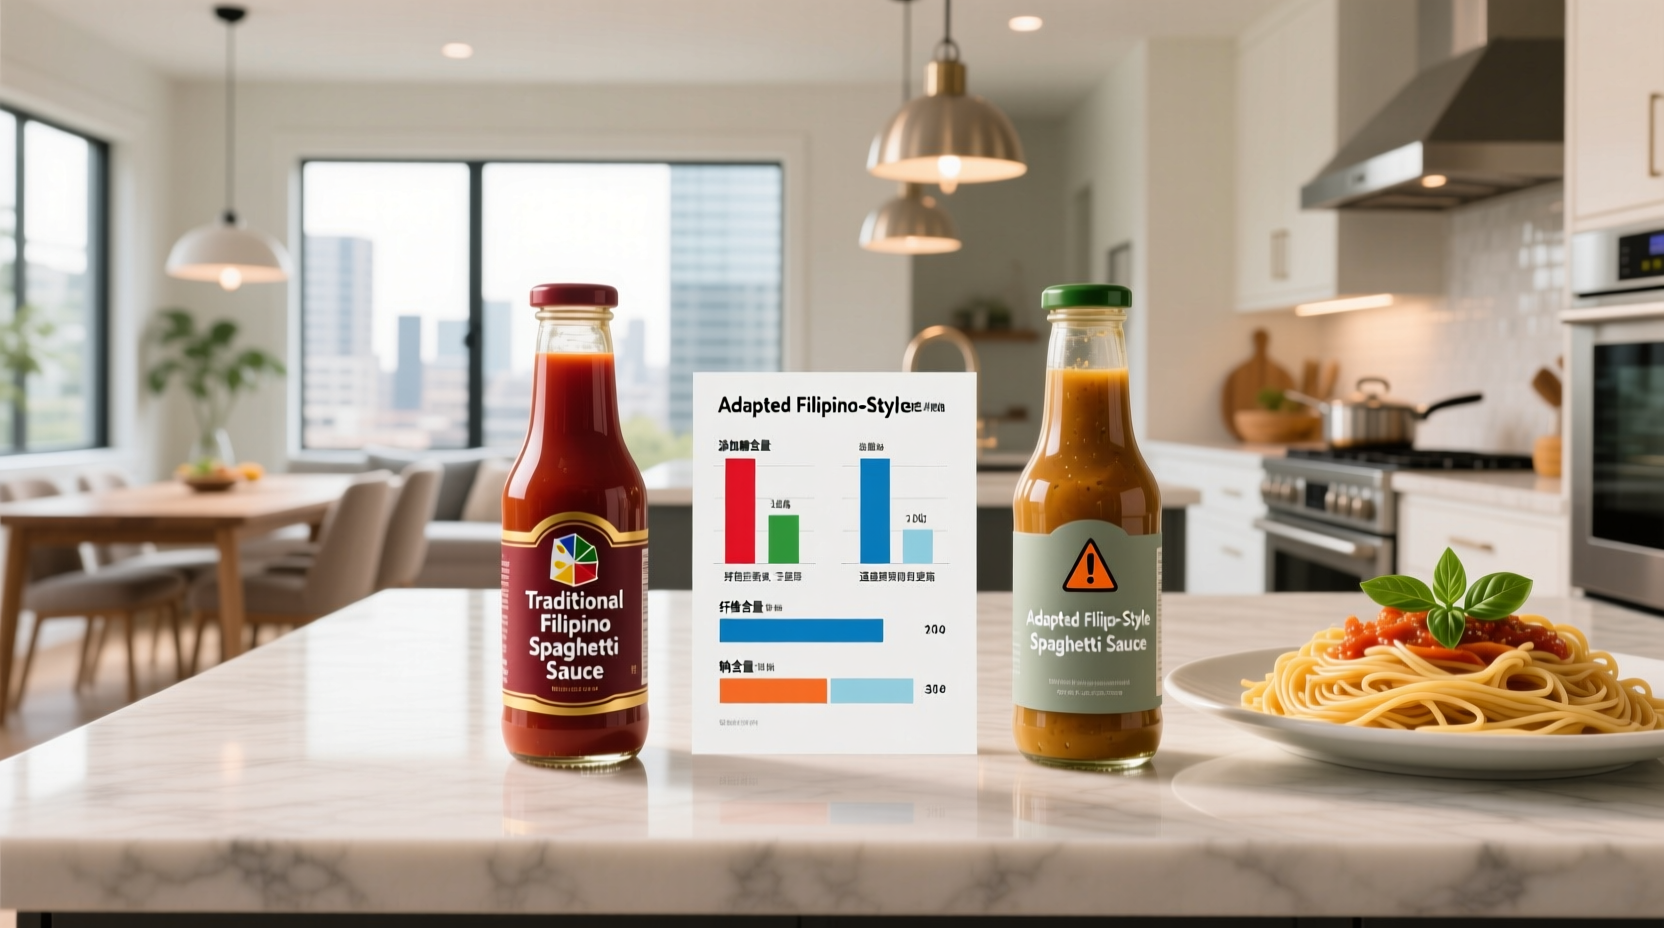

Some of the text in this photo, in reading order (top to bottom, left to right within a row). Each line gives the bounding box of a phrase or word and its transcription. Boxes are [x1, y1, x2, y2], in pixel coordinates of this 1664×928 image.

[718, 396, 790, 418] Adapted
[797, 396, 911, 418] Filipino-Style
[525, 588, 624, 609] Traditional
[540, 613, 611, 638] Filipino
[1025, 608, 1080, 631] Adapted
[528, 636, 619, 662] Spaghetti
[1030, 632, 1147, 657] Spaghetti Sauce
[546, 660, 604, 680] Sauce
